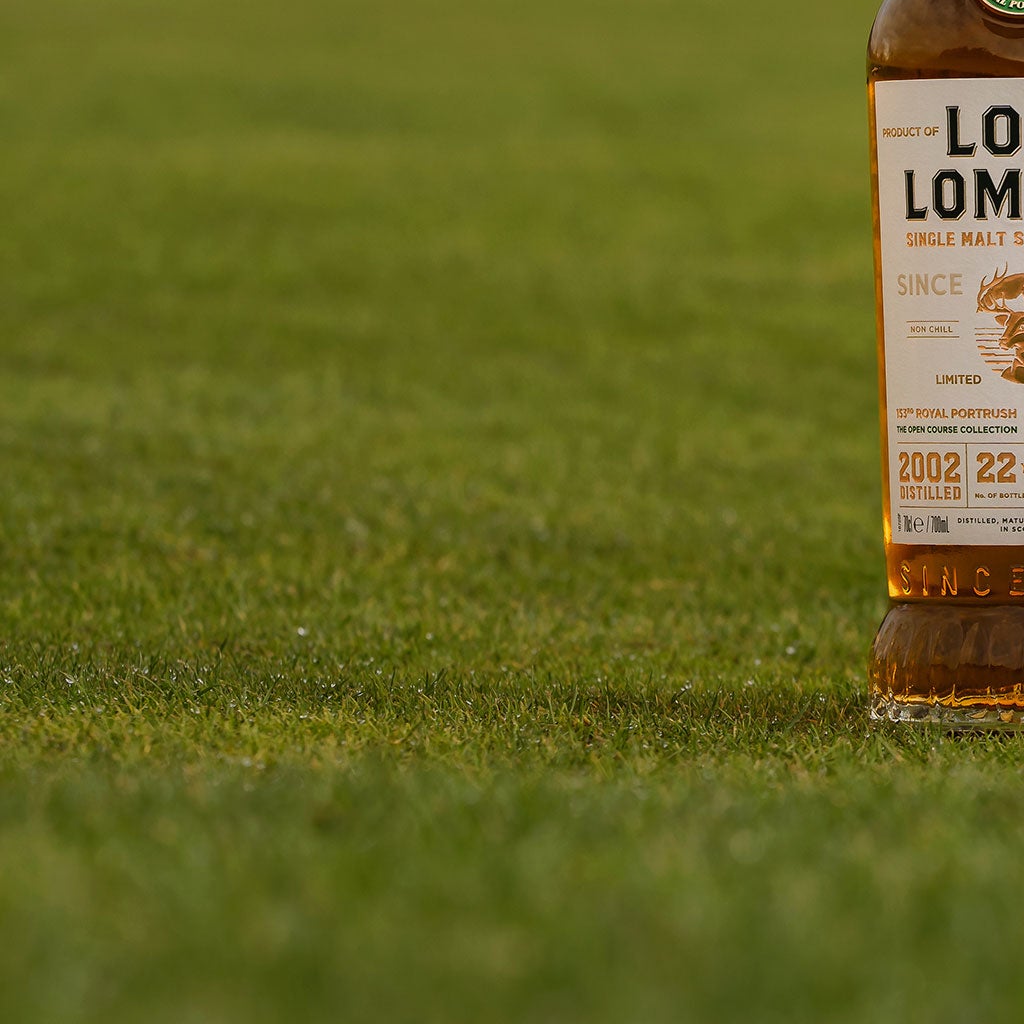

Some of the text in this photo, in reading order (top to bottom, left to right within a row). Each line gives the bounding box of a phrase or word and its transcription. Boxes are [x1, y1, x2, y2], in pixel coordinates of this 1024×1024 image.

[882, 126, 940, 138] PRODUCT OF
[906, 231, 956, 248] SINGLE
[961, 231, 1006, 247] MALT
[897, 273, 963, 296] SINCE
[910, 325, 953, 333] NON CHILL
[935, 374, 982, 385] LIMITED
[915, 408, 949, 419] ROYAL
[951, 408, 1017, 419] PORTRUSH
[896, 425, 1018, 434] THE OPEN COURSE COLLECTION
[898, 451, 961, 483] 2002
[976, 451, 1017, 484] 22
[899, 485, 962, 501] DISTILLED
[957, 517, 1000, 525] DISTILLED,
[900, 563, 1024, 597] SINCE
